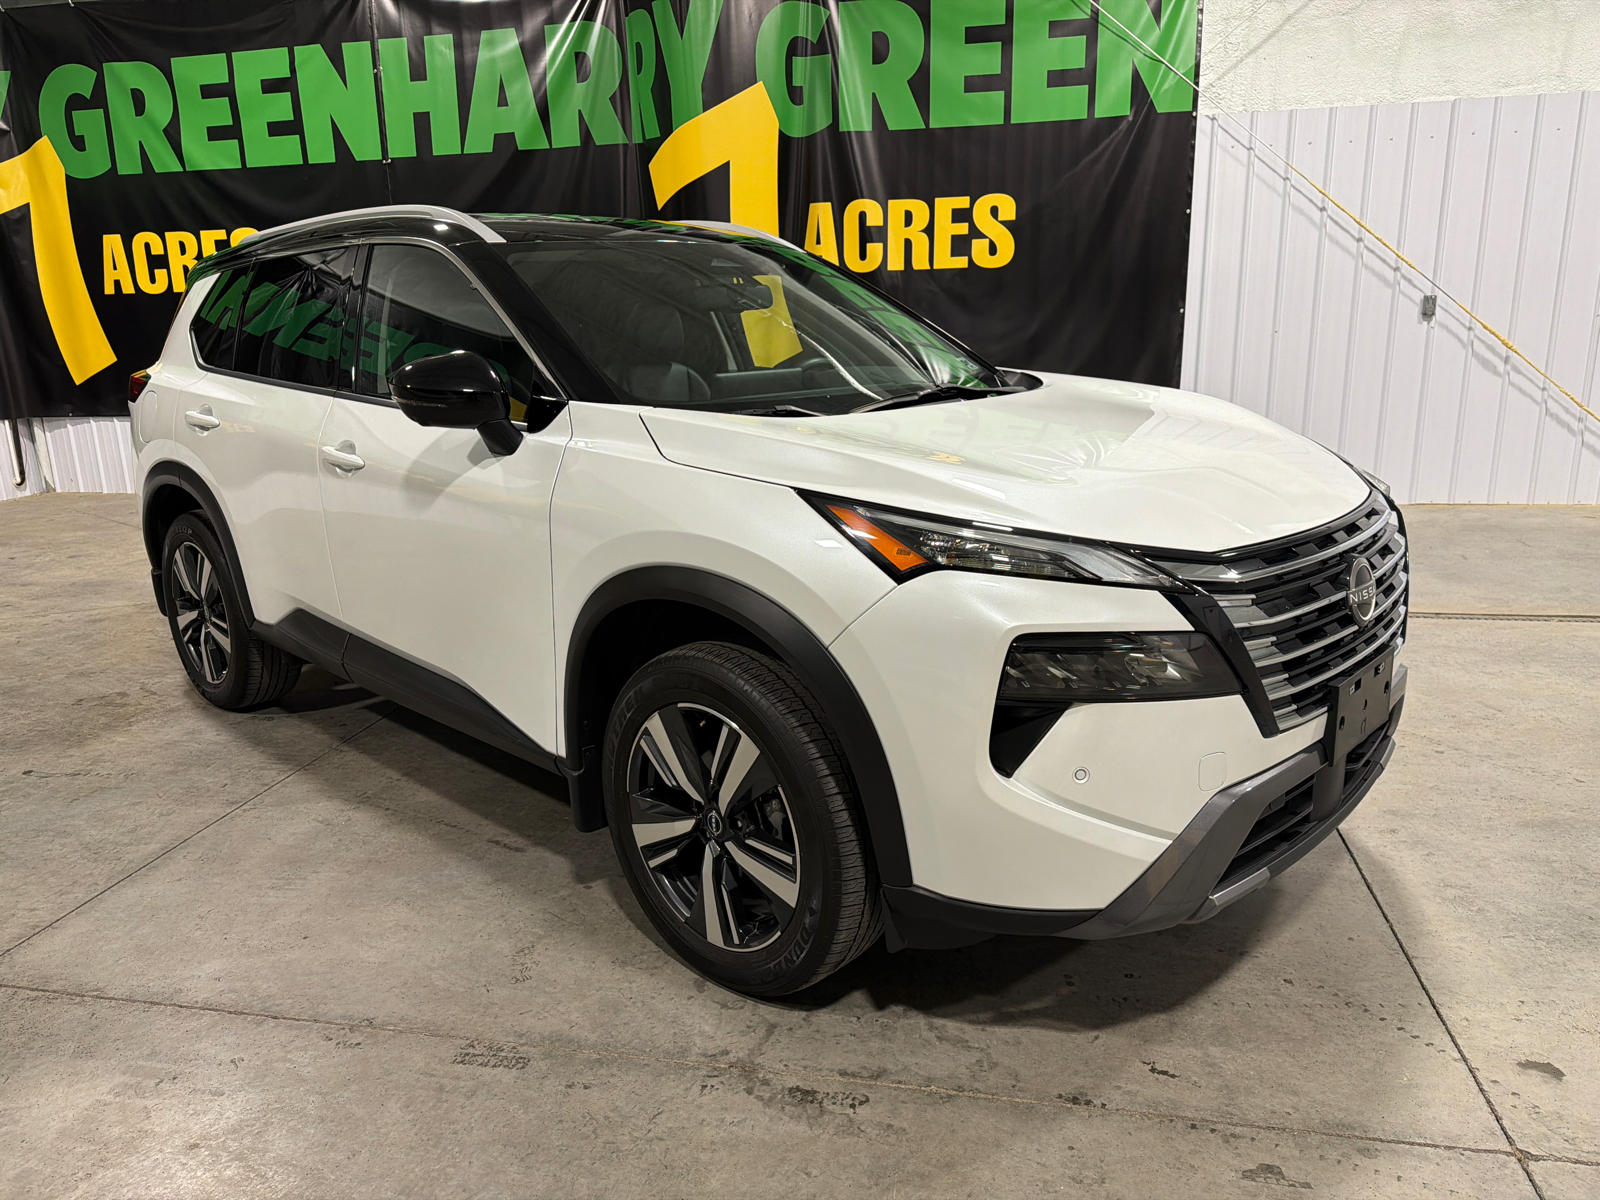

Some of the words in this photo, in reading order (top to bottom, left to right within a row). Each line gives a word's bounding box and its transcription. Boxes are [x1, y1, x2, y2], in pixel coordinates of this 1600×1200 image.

[39, 41, 382, 179] GREEN
[378, 0, 722, 158] HARRY
[755, 0, 1196, 138] GREEN
[804, 193, 1017, 273] ACRES
